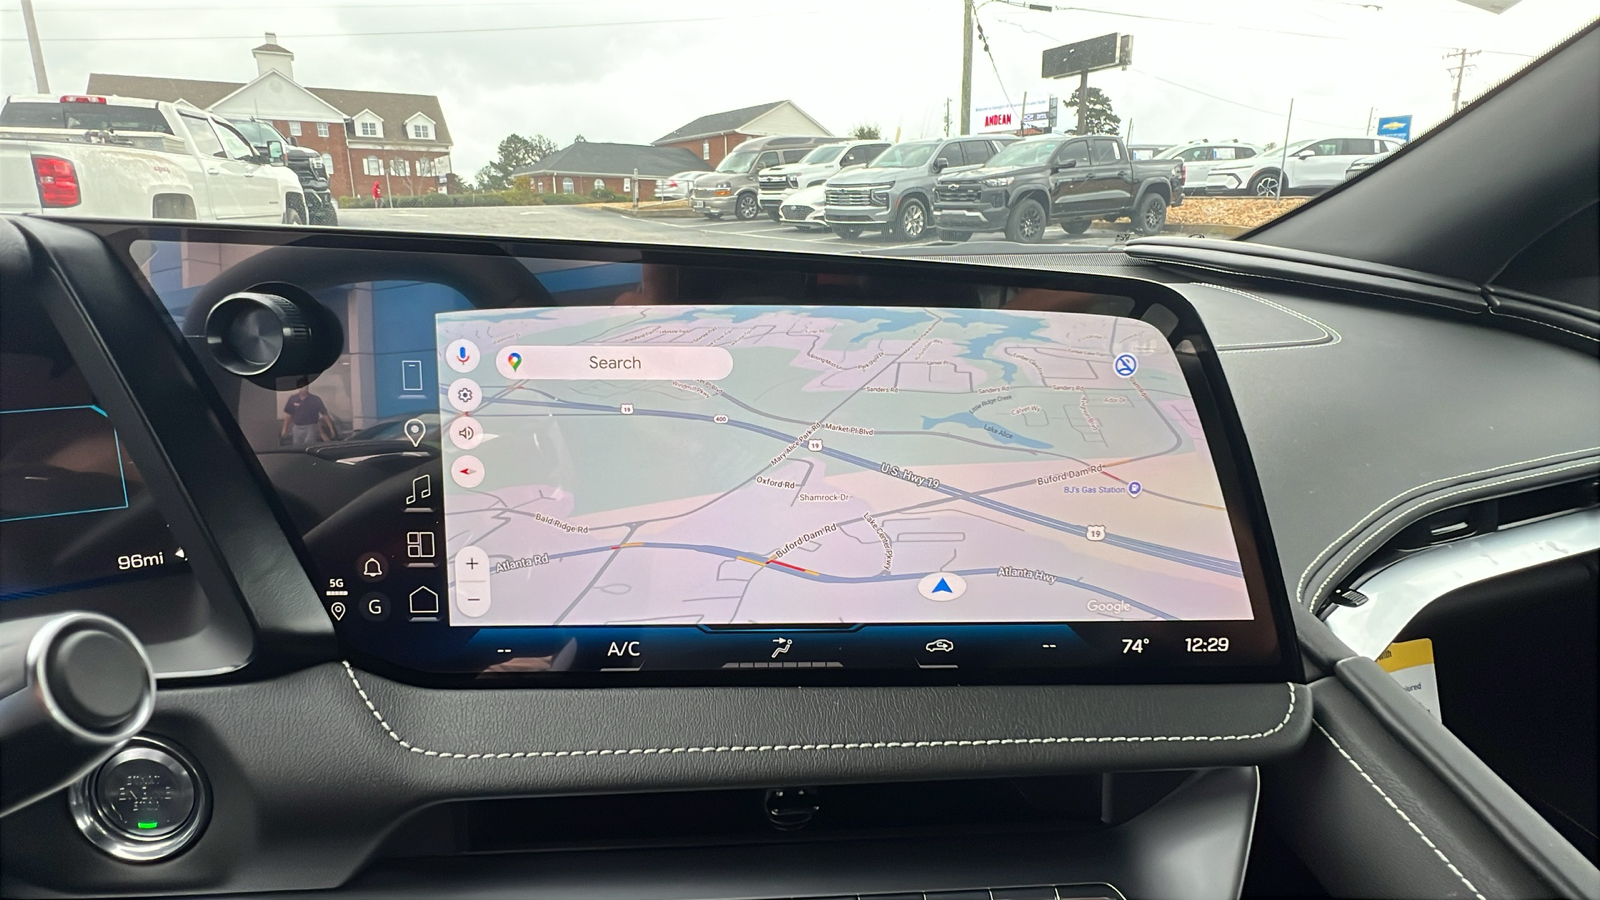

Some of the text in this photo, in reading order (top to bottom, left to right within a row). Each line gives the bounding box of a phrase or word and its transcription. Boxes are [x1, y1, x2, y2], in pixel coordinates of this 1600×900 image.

[984, 113, 1012, 127] ANDEAN
[589, 356, 642, 370] Search
[825, 423, 849, 433] Market
[858, 428, 874, 436] Blvd
[983, 424, 1014, 440] Lake Alice
[770, 422, 821, 466] Mary Alice Park Rd
[880, 462, 941, 489] U.S. Hwy 19
[1037, 464, 1103, 485] Buford Dam Rd
[756, 476, 796, 489] Oxford Rd
[1063, 485, 1126, 494] BJ's Gas Station
[799, 492, 850, 501] Shamrock Dr
[535, 513, 589, 534] Bald Ridge Rd
[775, 523, 837, 559] Buford Dam Rd
[863, 512, 893, 571] Lake Center Pkwy
[1090, 530, 1101, 538] 19
[117, 551, 165, 571] 96mi
[496, 553, 550, 573] Atlanta Rd
[329, 578, 344, 588] 5G
[997, 566, 1058, 585] Atlanta Hwy
[368, 599, 382, 614] G
[1086, 600, 1131, 613] Google
[607, 641, 641, 657] A/C
[1185, 637, 1230, 652] 12:29
